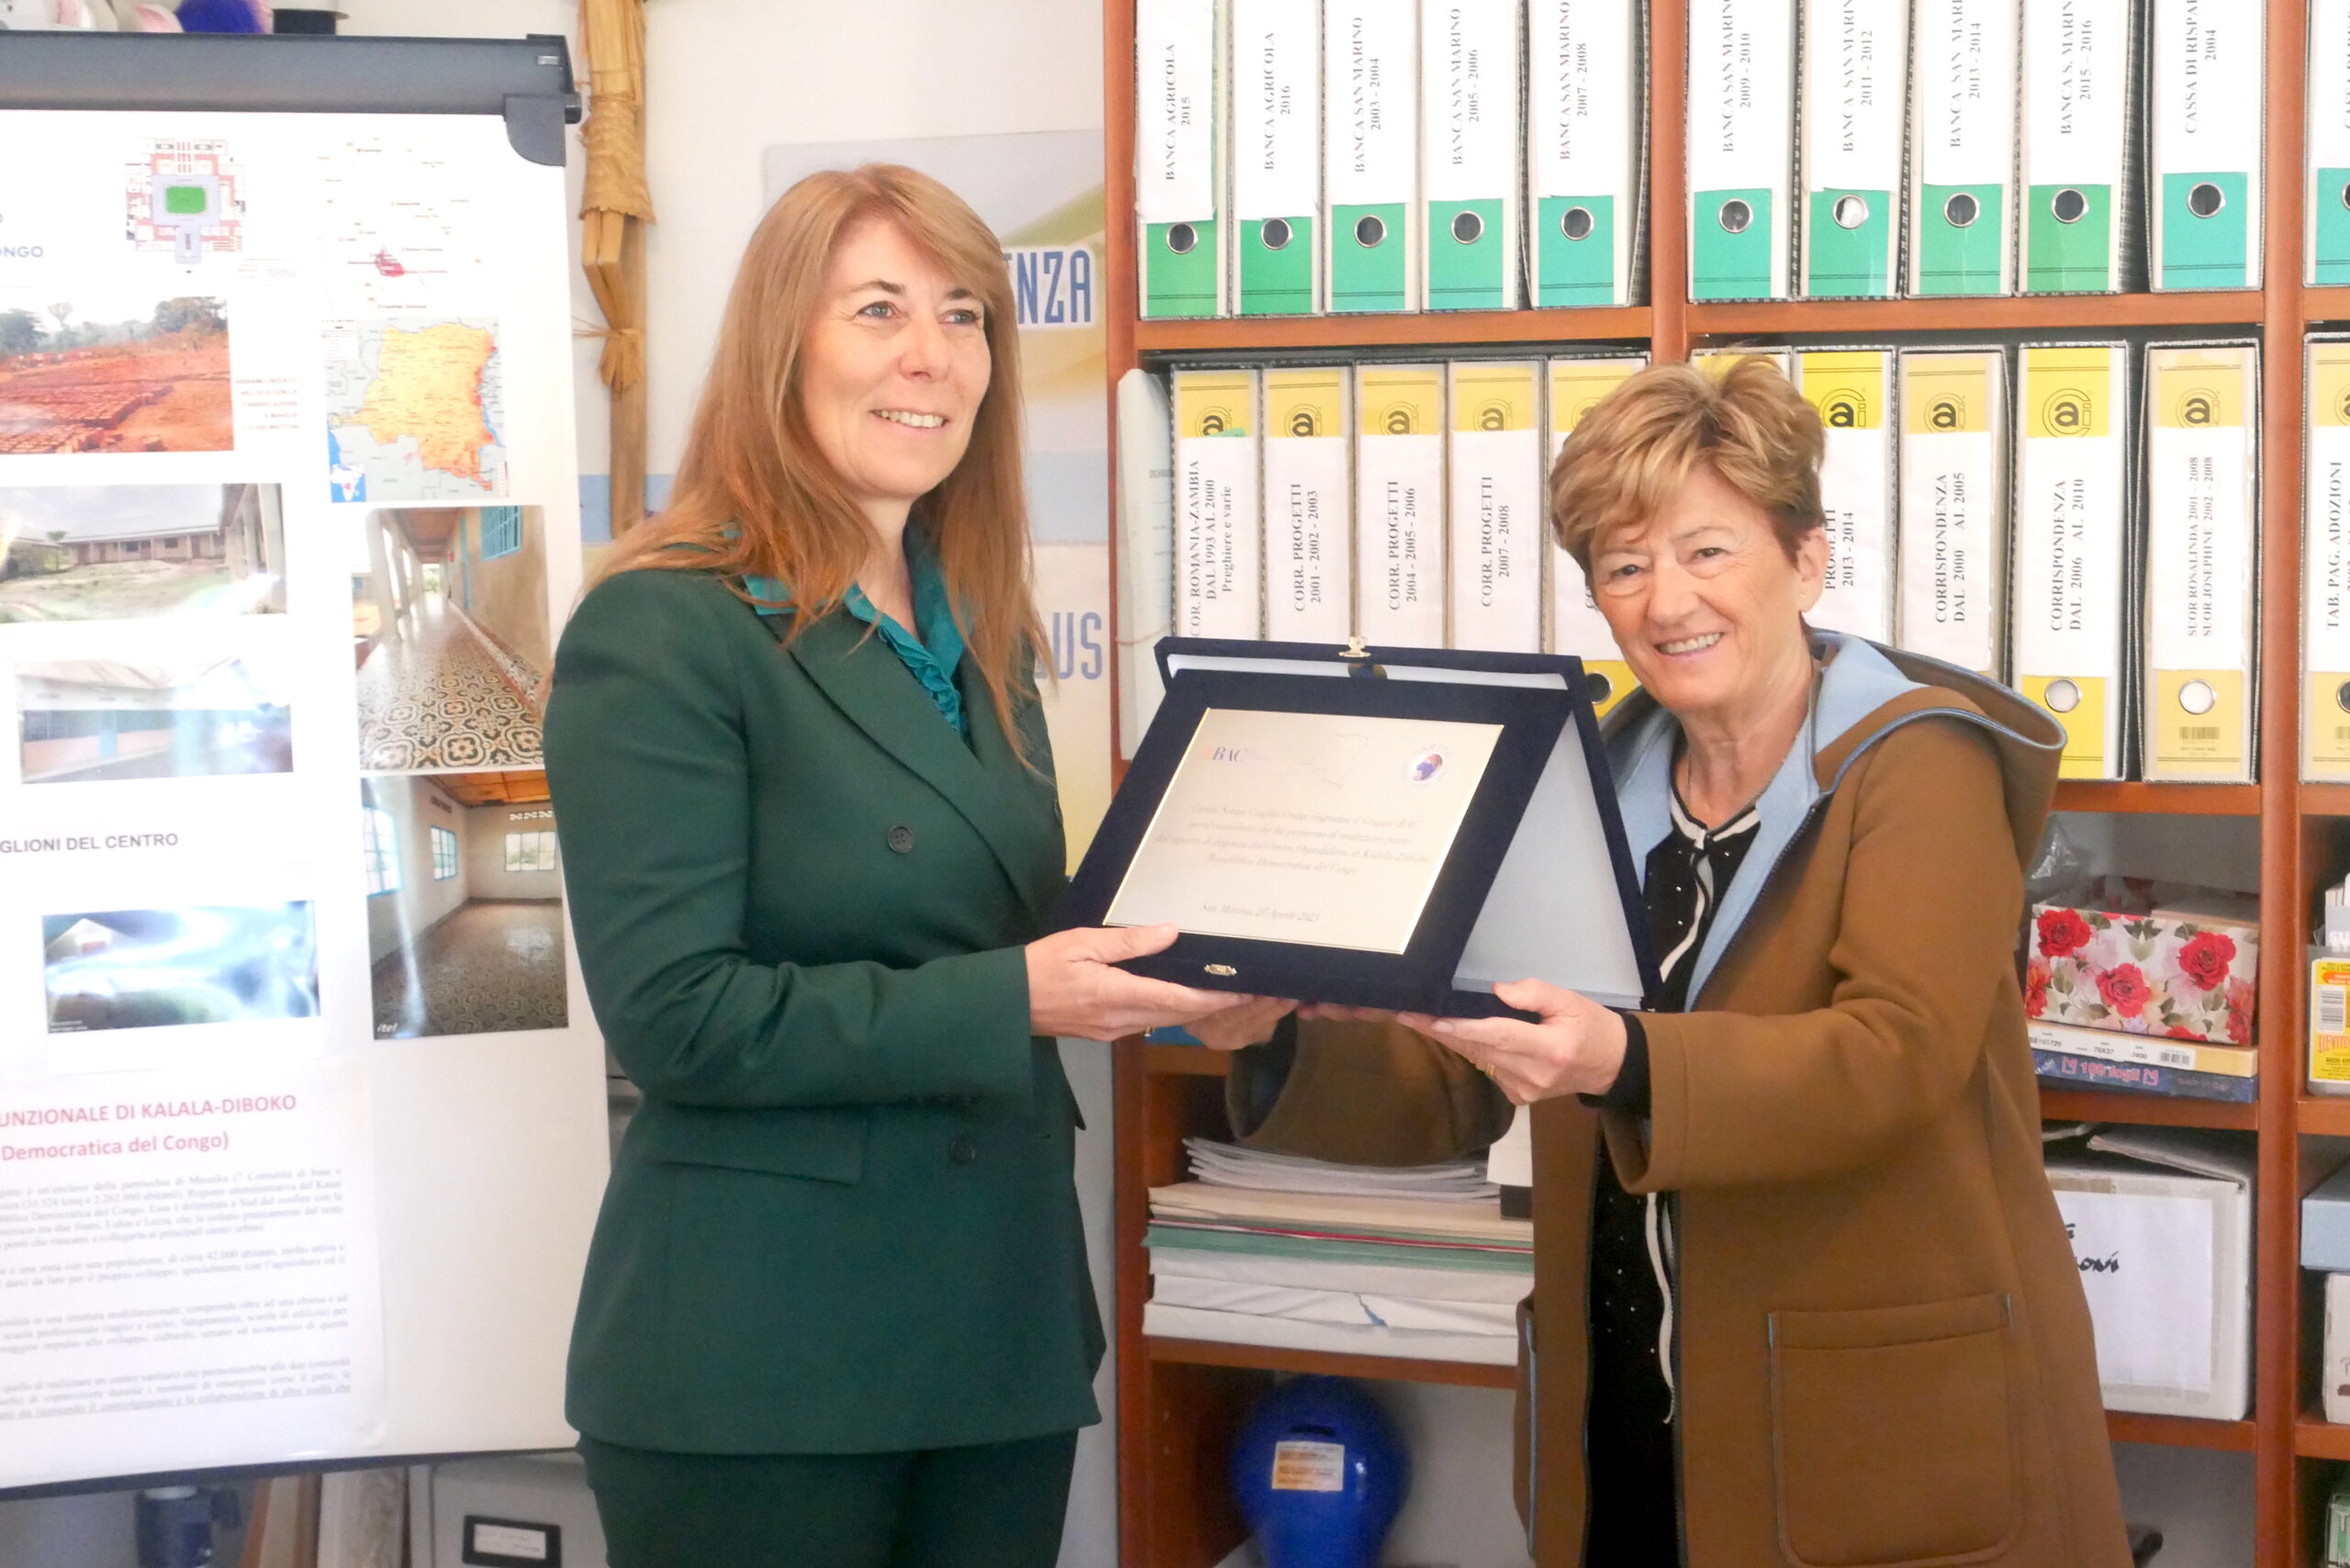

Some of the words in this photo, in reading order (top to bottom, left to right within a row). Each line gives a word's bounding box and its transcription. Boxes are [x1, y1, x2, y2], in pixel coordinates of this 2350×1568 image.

[1352, 17, 1363, 81] MARINO
[1450, 8, 1461, 73] MARINO
[1560, 2, 1570, 67] MARINO
[1740, 33, 1751, 63] 2010
[1862, 30, 1872, 61] 2012
[1969, 22, 1981, 53] 2014
[2080, 20, 2092, 51] 2016
[2205, 29, 2217, 61] 2004
[1264, 32, 1274, 113] AGRICOLA
[1370, 58, 1380, 87] 2004
[1469, 50, 1479, 79] 2006
[1577, 43, 1587, 73] 2008
[1843, 58, 1854, 88] SAN
[1952, 52, 1962, 83] SAN
[2062, 61, 2073, 78] S.
[2186, 58, 2198, 75] DI
[1166, 44, 1176, 124] AGRICOLA
[1452, 78, 1461, 107] SAN
[1561, 73, 1571, 102] SAN
[1722, 62, 1734, 94] SAN
[1740, 78, 1751, 108] 2009
[1862, 76, 1872, 106] 2011
[1969, 70, 1980, 99] 2013
[2079, 69, 2092, 100] 2015
[1181, 96, 1191, 126] 2015
[1281, 85, 1291, 115] 2016
[1353, 86, 1364, 116] SAN
[1371, 101, 1381, 130] 2003
[1469, 93, 1479, 123] 2005
[1577, 87, 1587, 118] 2007
[2061, 80, 2073, 135] BANCA
[2185, 81, 2198, 134] CASSA
[1560, 106, 1571, 160] BANCA
[1722, 97, 1734, 152] BANCA
[1843, 97, 1854, 151] BANCA
[1950, 93, 1962, 147] BANCA
[1264, 118, 1275, 170] BANCA
[1354, 121, 1365, 173] BANCA
[1452, 112, 1463, 165] BANCA
[1166, 129, 1175, 180] BANCA
[0, 246, 44, 258] NGO
[1004, 250, 1091, 324] NZA
[2189, 457, 2199, 482] 2008
[2204, 457, 2213, 482] 2008
[1205, 479, 1214, 510] 2000
[1224, 486, 1232, 521] varie
[1404, 487, 1416, 518] 2006
[1953, 472, 1965, 504] 2005
[2073, 479, 2084, 510] 2010
[2330, 462, 2342, 544] ADOZIONI
[1309, 490, 1318, 521] 2003
[1388, 481, 1399, 559] PROGETTI
[1482, 476, 1493, 555] PROGETTI
[1498, 505, 1509, 536] 2008
[1953, 508, 1965, 530] AL
[1190, 461, 1200, 599] ROMANIA-ZAMBIA
[1205, 512, 1215, 532] AL
[1225, 524, 1232, 533] e
[1291, 484, 1304, 560] PROGETTI
[1843, 512, 1853, 543] 2014
[2072, 520, 2084, 541] AL
[1205, 537, 1215, 565] 1993
[1310, 532, 1320, 561] 2002
[1405, 531, 1416, 560] 2005
[1935, 474, 1947, 623] CORRISPONDENZA
[2051, 481, 2066, 631] CORRISPONDENZA
[1223, 537, 1234, 593] Preghiere
[1498, 548, 1509, 577] 2007
[1843, 556, 1854, 587] 2013
[1953, 550, 1965, 581] 2000
[2071, 557, 2083, 588] 2006
[2188, 524, 2198, 599] ROSALINDA
[2203, 528, 2212, 599] JOSEPHINE
[2328, 551, 2340, 588] PAG.
[1207, 572, 1216, 600] DAL
[1294, 564, 1304, 611] CORR.
[1311, 574, 1321, 603] 2001
[1389, 564, 1400, 610] CORR.
[1406, 573, 1416, 602] 2004
[1482, 560, 1493, 607] CORR.
[1953, 589, 1965, 622] DAL
[2069, 598, 2082, 631] DAL
[2188, 602, 2198, 636] SUOR
[2203, 602, 2212, 636] SUOR
[2328, 593, 2339, 630] TAB.
[1035, 612, 1102, 680] US
[0, 839, 61, 853] GLIONI
[66, 837, 100, 850] DEL
[106, 834, 179, 848] CENTRO
[116, 1104, 135, 1121] DI
[141, 1094, 297, 1119] KALALA-DIBOKO
[2, 1139, 122, 1161] Democratica
[129, 1136, 158, 1153] del
[163, 1131, 229, 1155] Congo)
